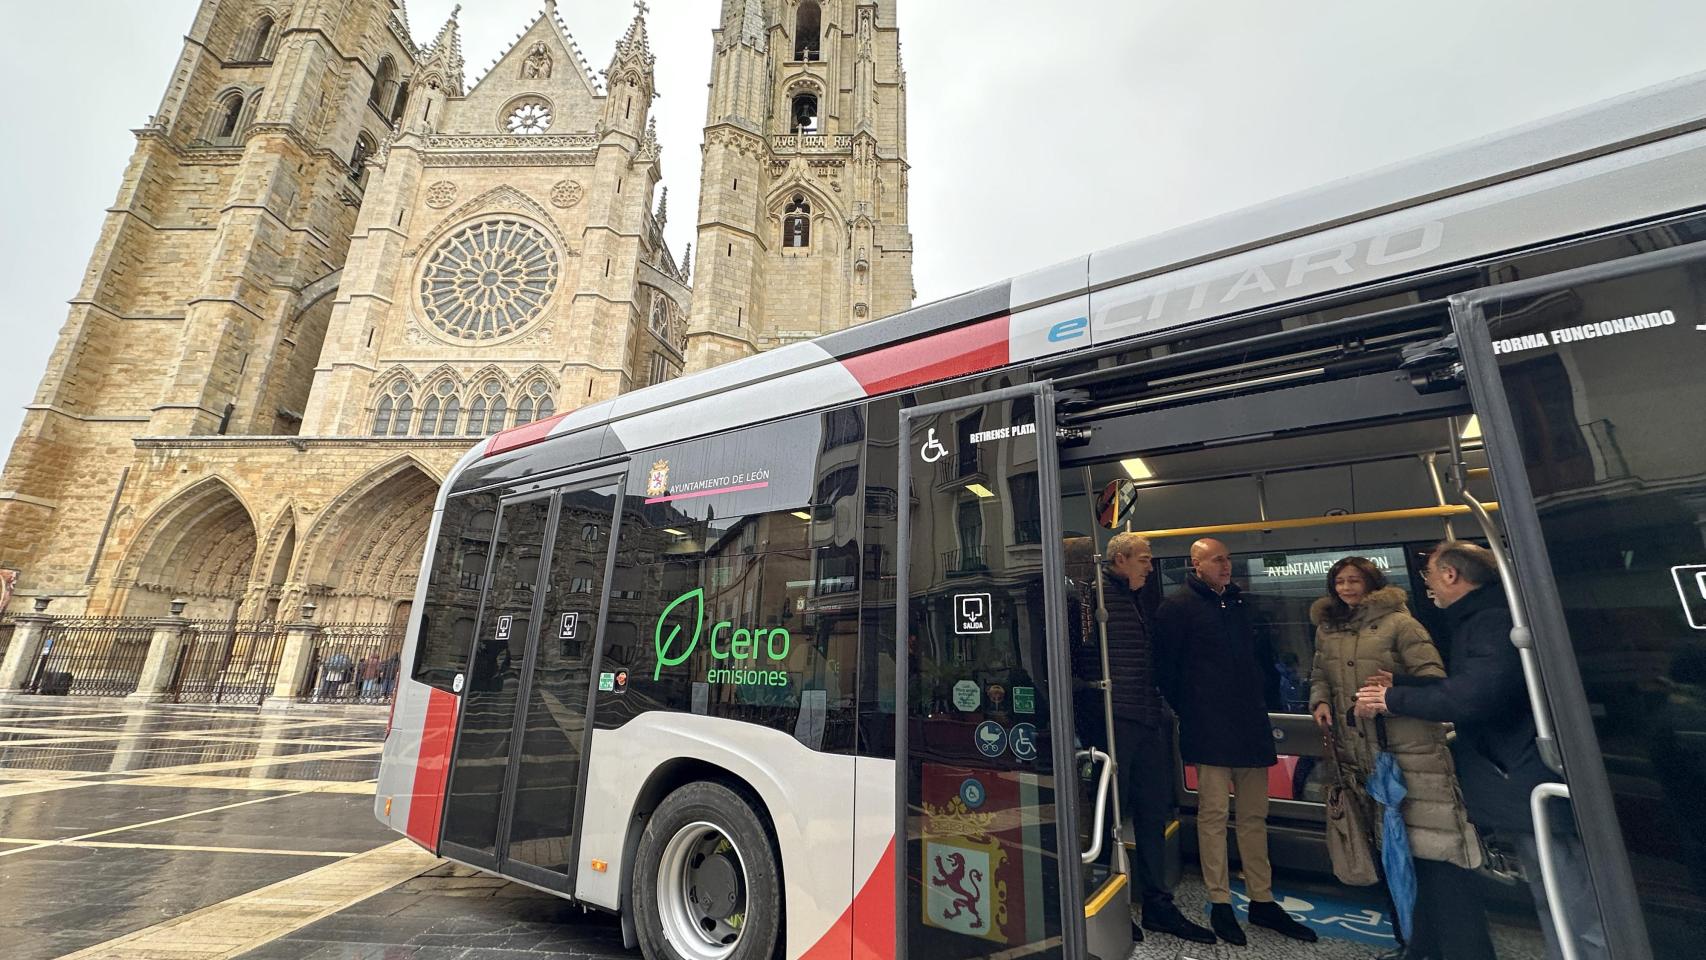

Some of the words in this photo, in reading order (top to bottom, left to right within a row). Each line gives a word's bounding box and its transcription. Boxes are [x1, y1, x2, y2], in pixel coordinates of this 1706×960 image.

[1491, 332, 1549, 355] FORMA
[1550, 309, 1676, 345] FUNCIONANDO
[969, 427, 1010, 444] RETIRENSE
[1011, 422, 1036, 437] PLATA
[669, 476, 730, 494] AYUNTAMIENTO
[732, 473, 744, 484] DE
[746, 468, 770, 482] LEÓN
[963, 621, 983, 630] SALIDA
[710, 621, 790, 660] Cero
[707, 665, 788, 687] emisiones
